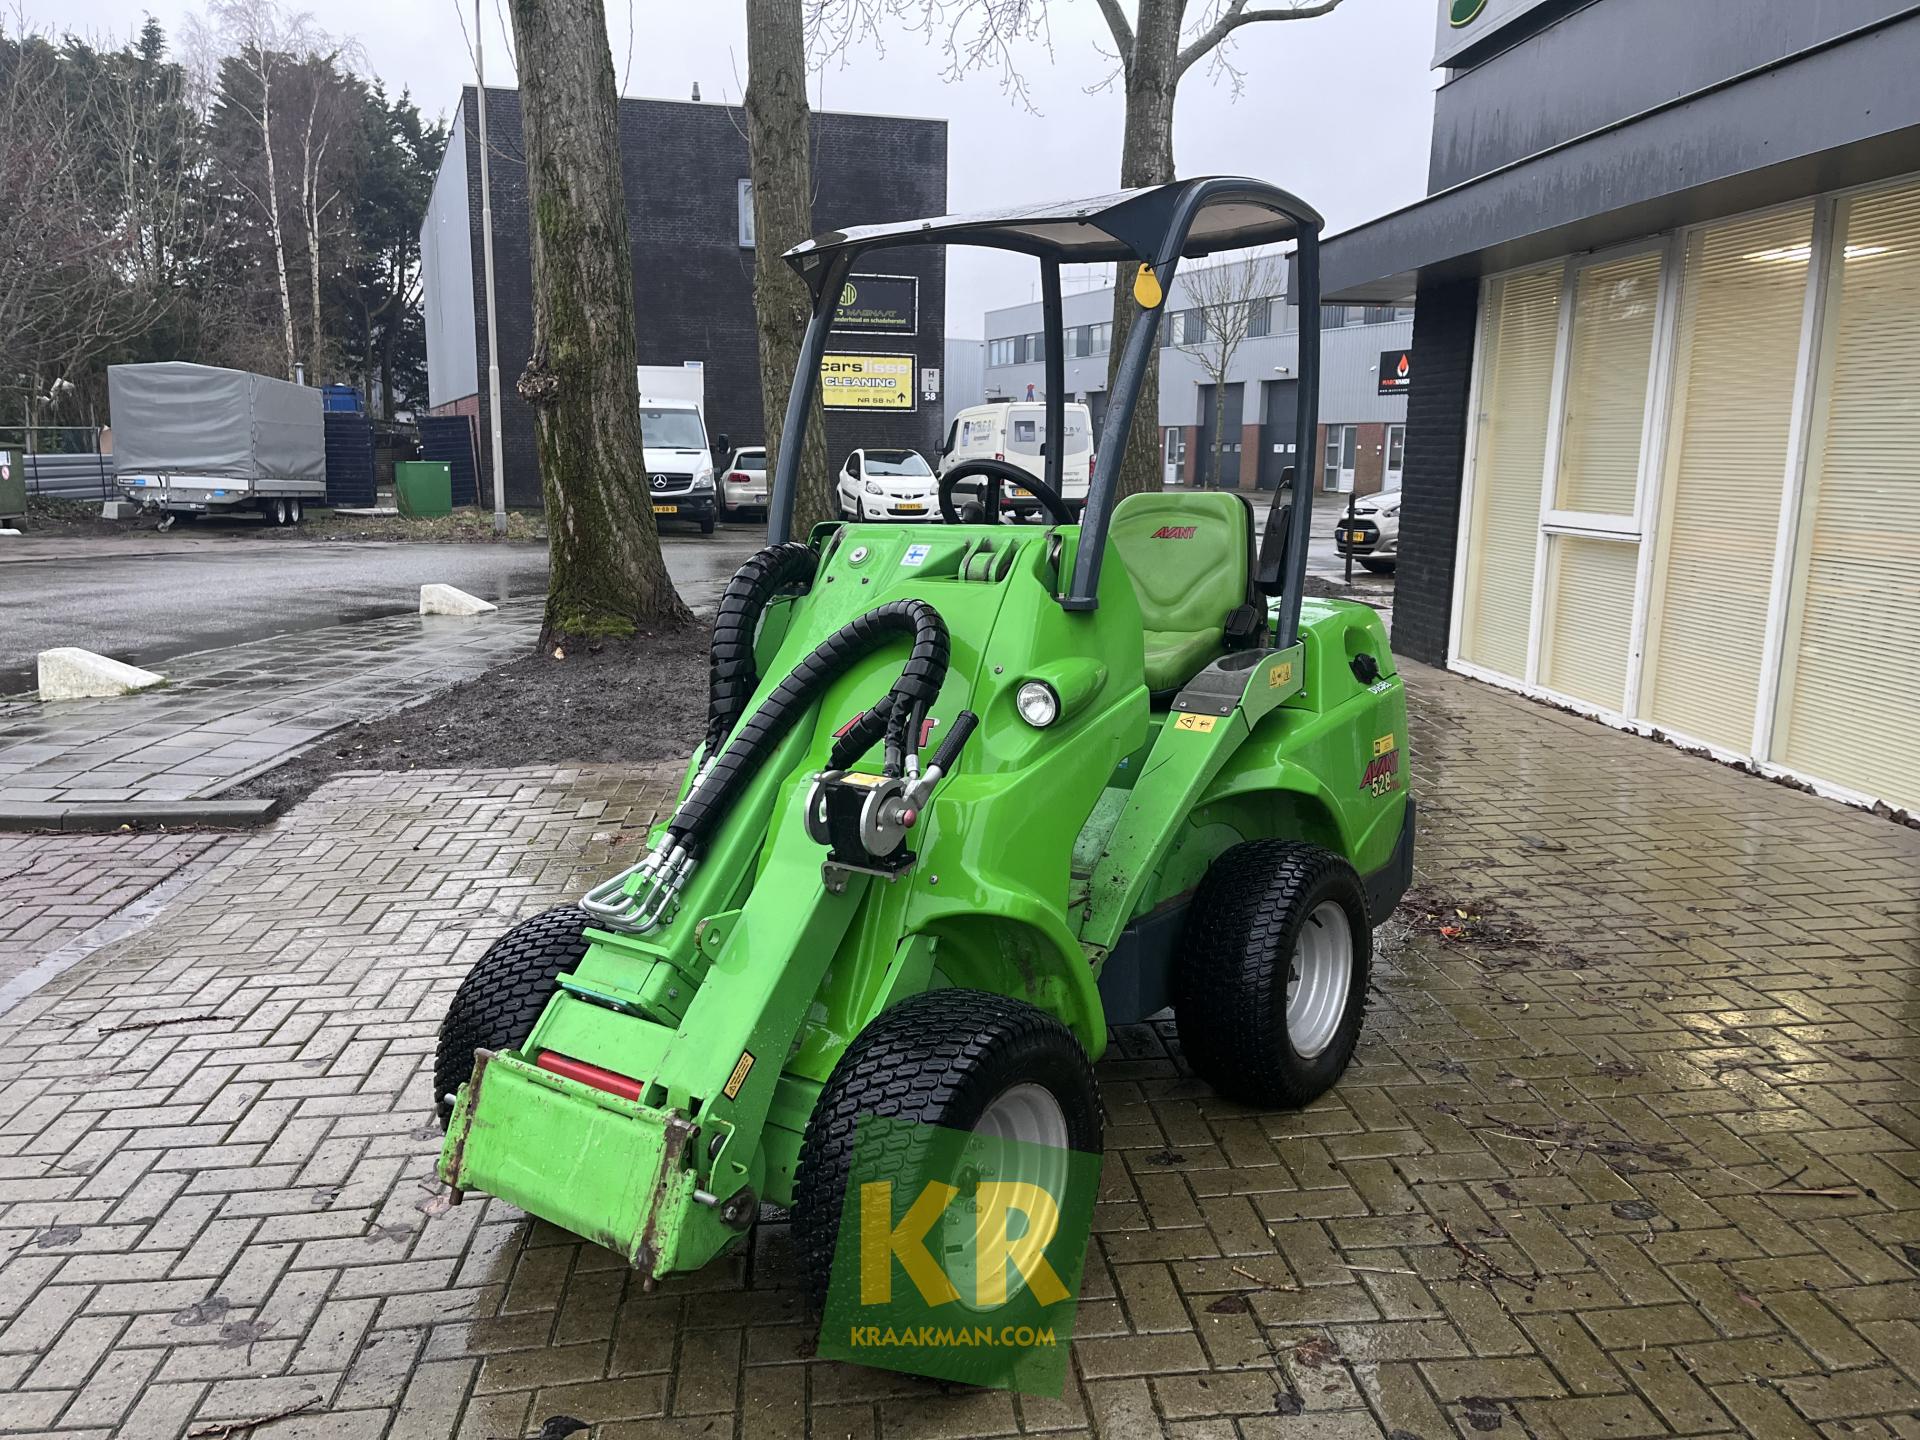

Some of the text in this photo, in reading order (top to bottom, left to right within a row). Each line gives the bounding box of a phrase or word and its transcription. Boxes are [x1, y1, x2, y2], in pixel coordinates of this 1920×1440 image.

[928, 370, 935, 378] H
[824, 376, 897, 388] CLEANING
[924, 392, 936, 401] 58
[1150, 526, 1198, 540] AVANT
[1359, 748, 1400, 789] AVANT
[1372, 771, 1391, 799] 528
